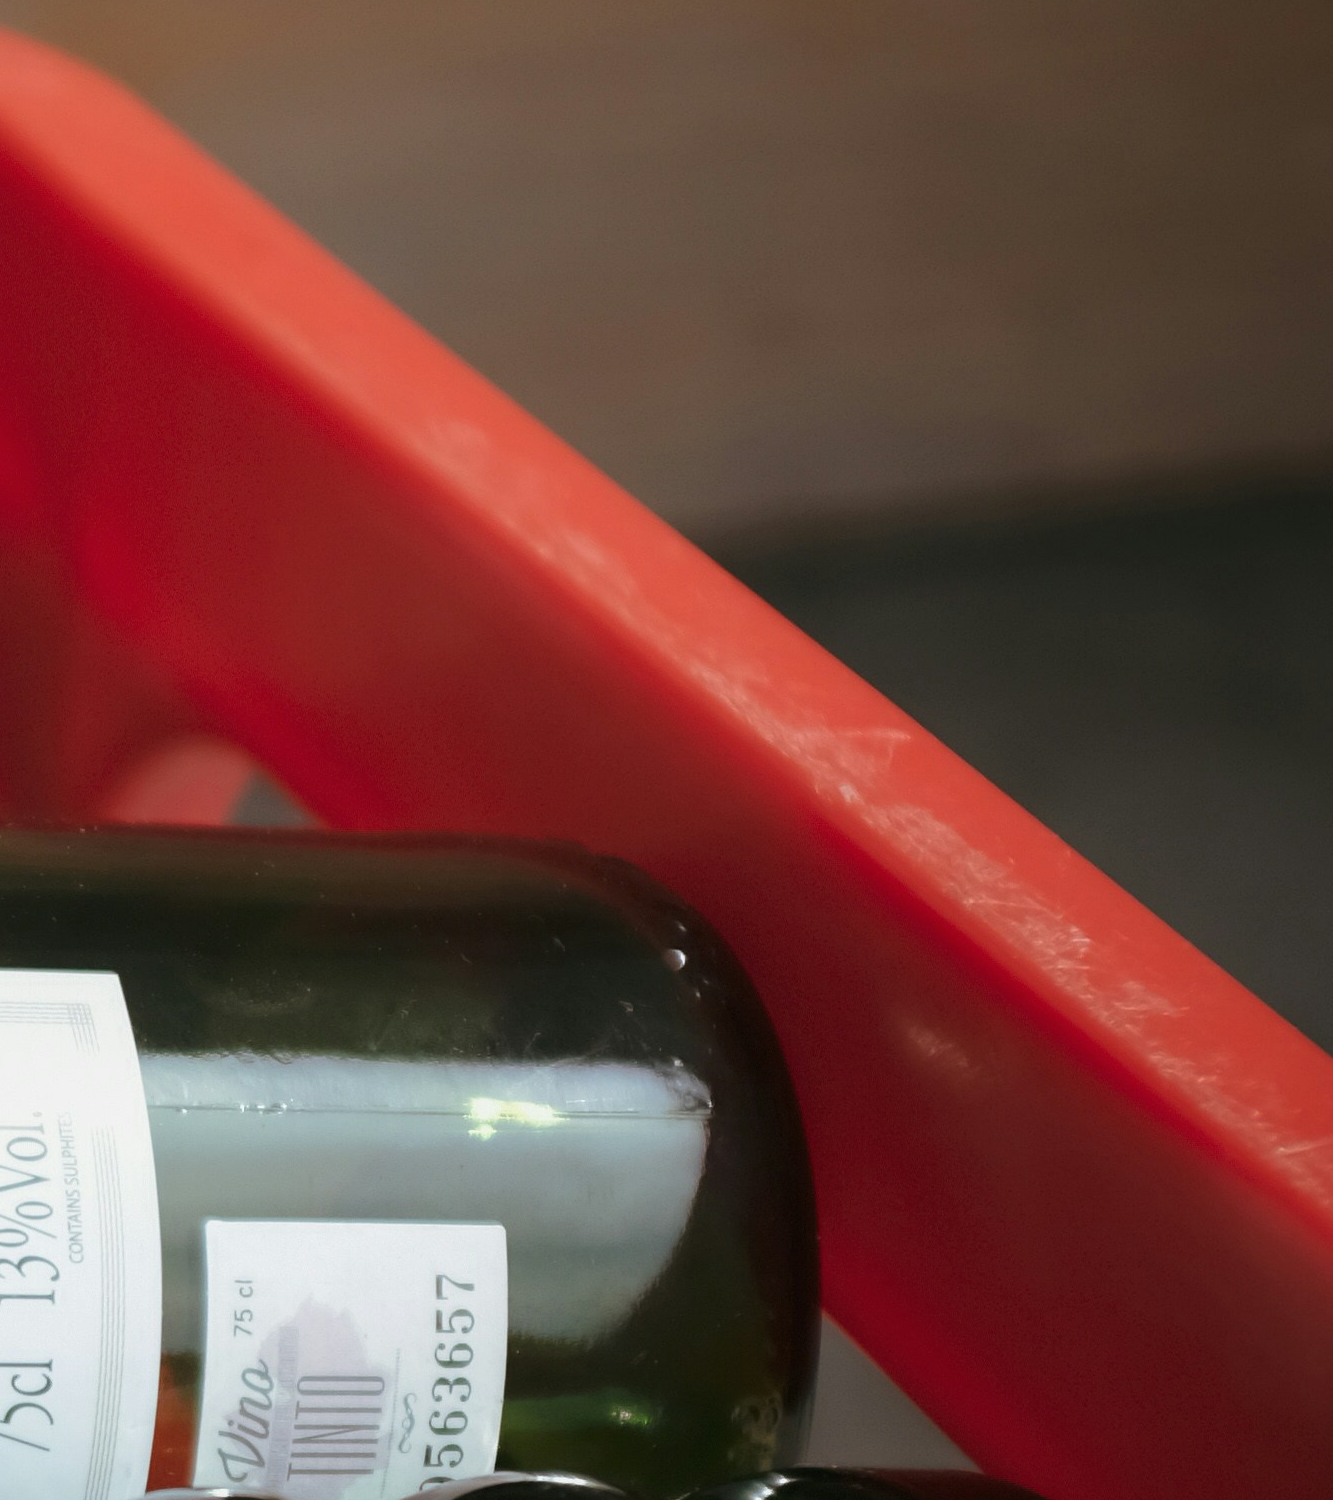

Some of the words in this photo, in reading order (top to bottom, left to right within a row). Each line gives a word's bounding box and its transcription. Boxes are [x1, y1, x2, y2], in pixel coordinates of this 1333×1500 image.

[55, 1110, 81, 1186] SULPHITES
[63, 1188, 86, 1265] CONTAINS
[234, 1279, 254, 1298] cl
[234, 1308, 255, 1338] 75
[217, 1358, 275, 1483] Vino
[285, 1373, 386, 1482] TINTO
